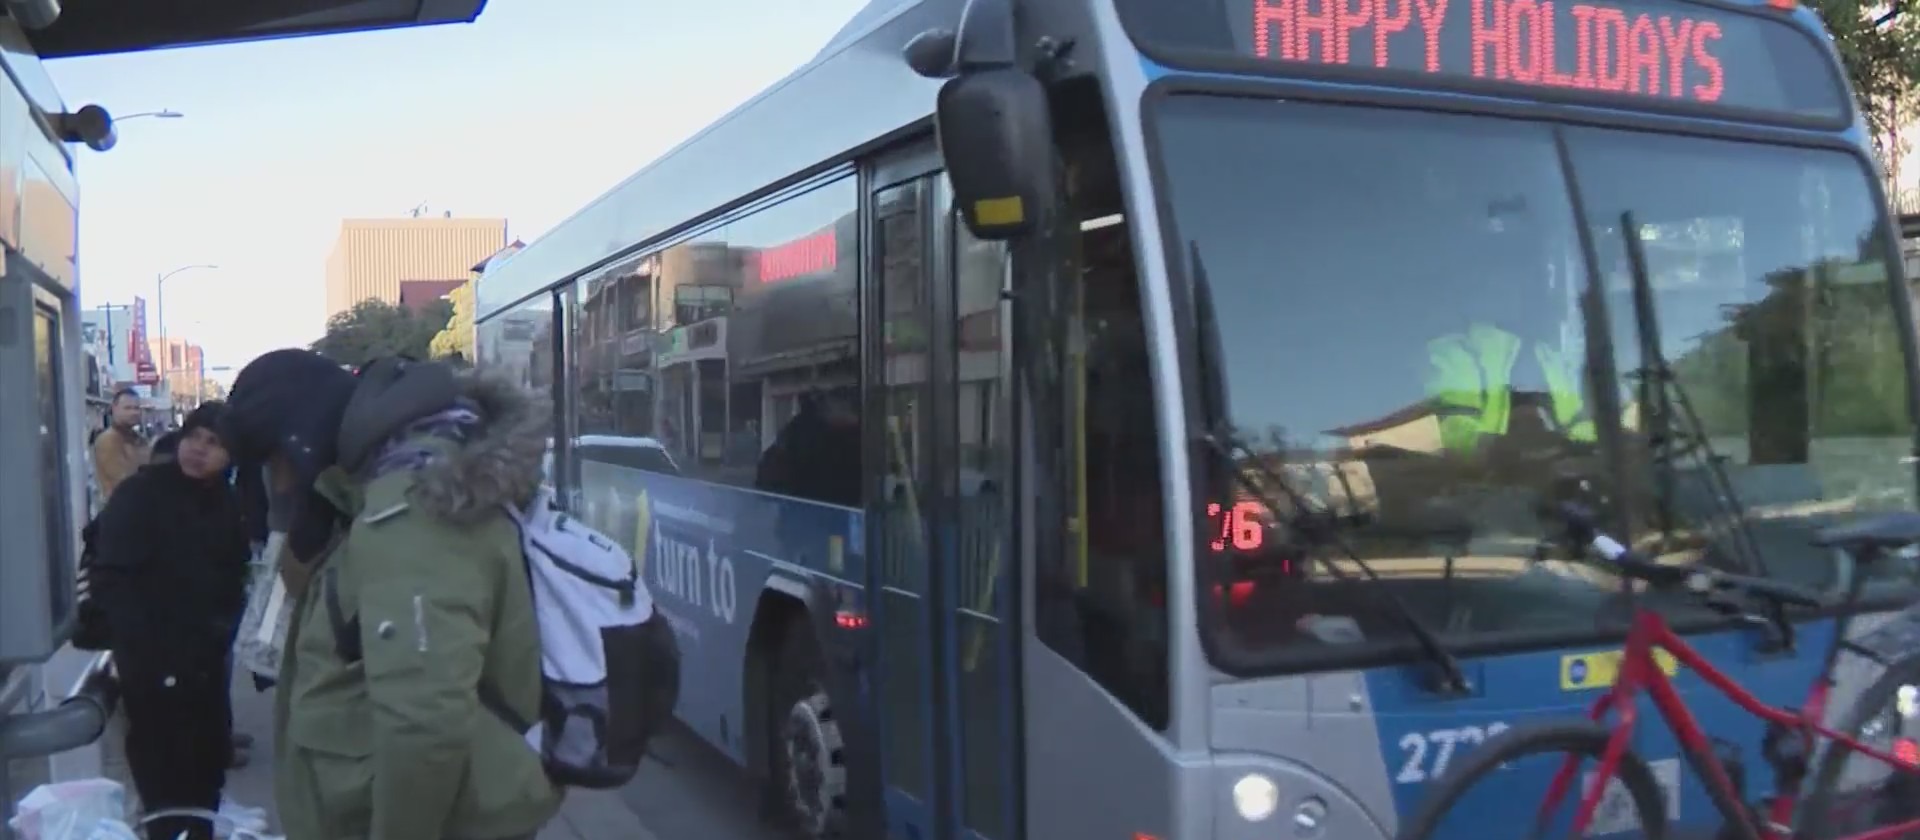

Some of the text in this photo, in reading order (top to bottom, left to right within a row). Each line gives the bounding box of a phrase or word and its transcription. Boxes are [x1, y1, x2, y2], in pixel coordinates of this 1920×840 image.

[1253, 0, 1724, 102] HAPPY HOLIDAYS
[655, 519, 701, 606] turn
[707, 537, 736, 624] to
[1396, 721, 1510, 783] 27
